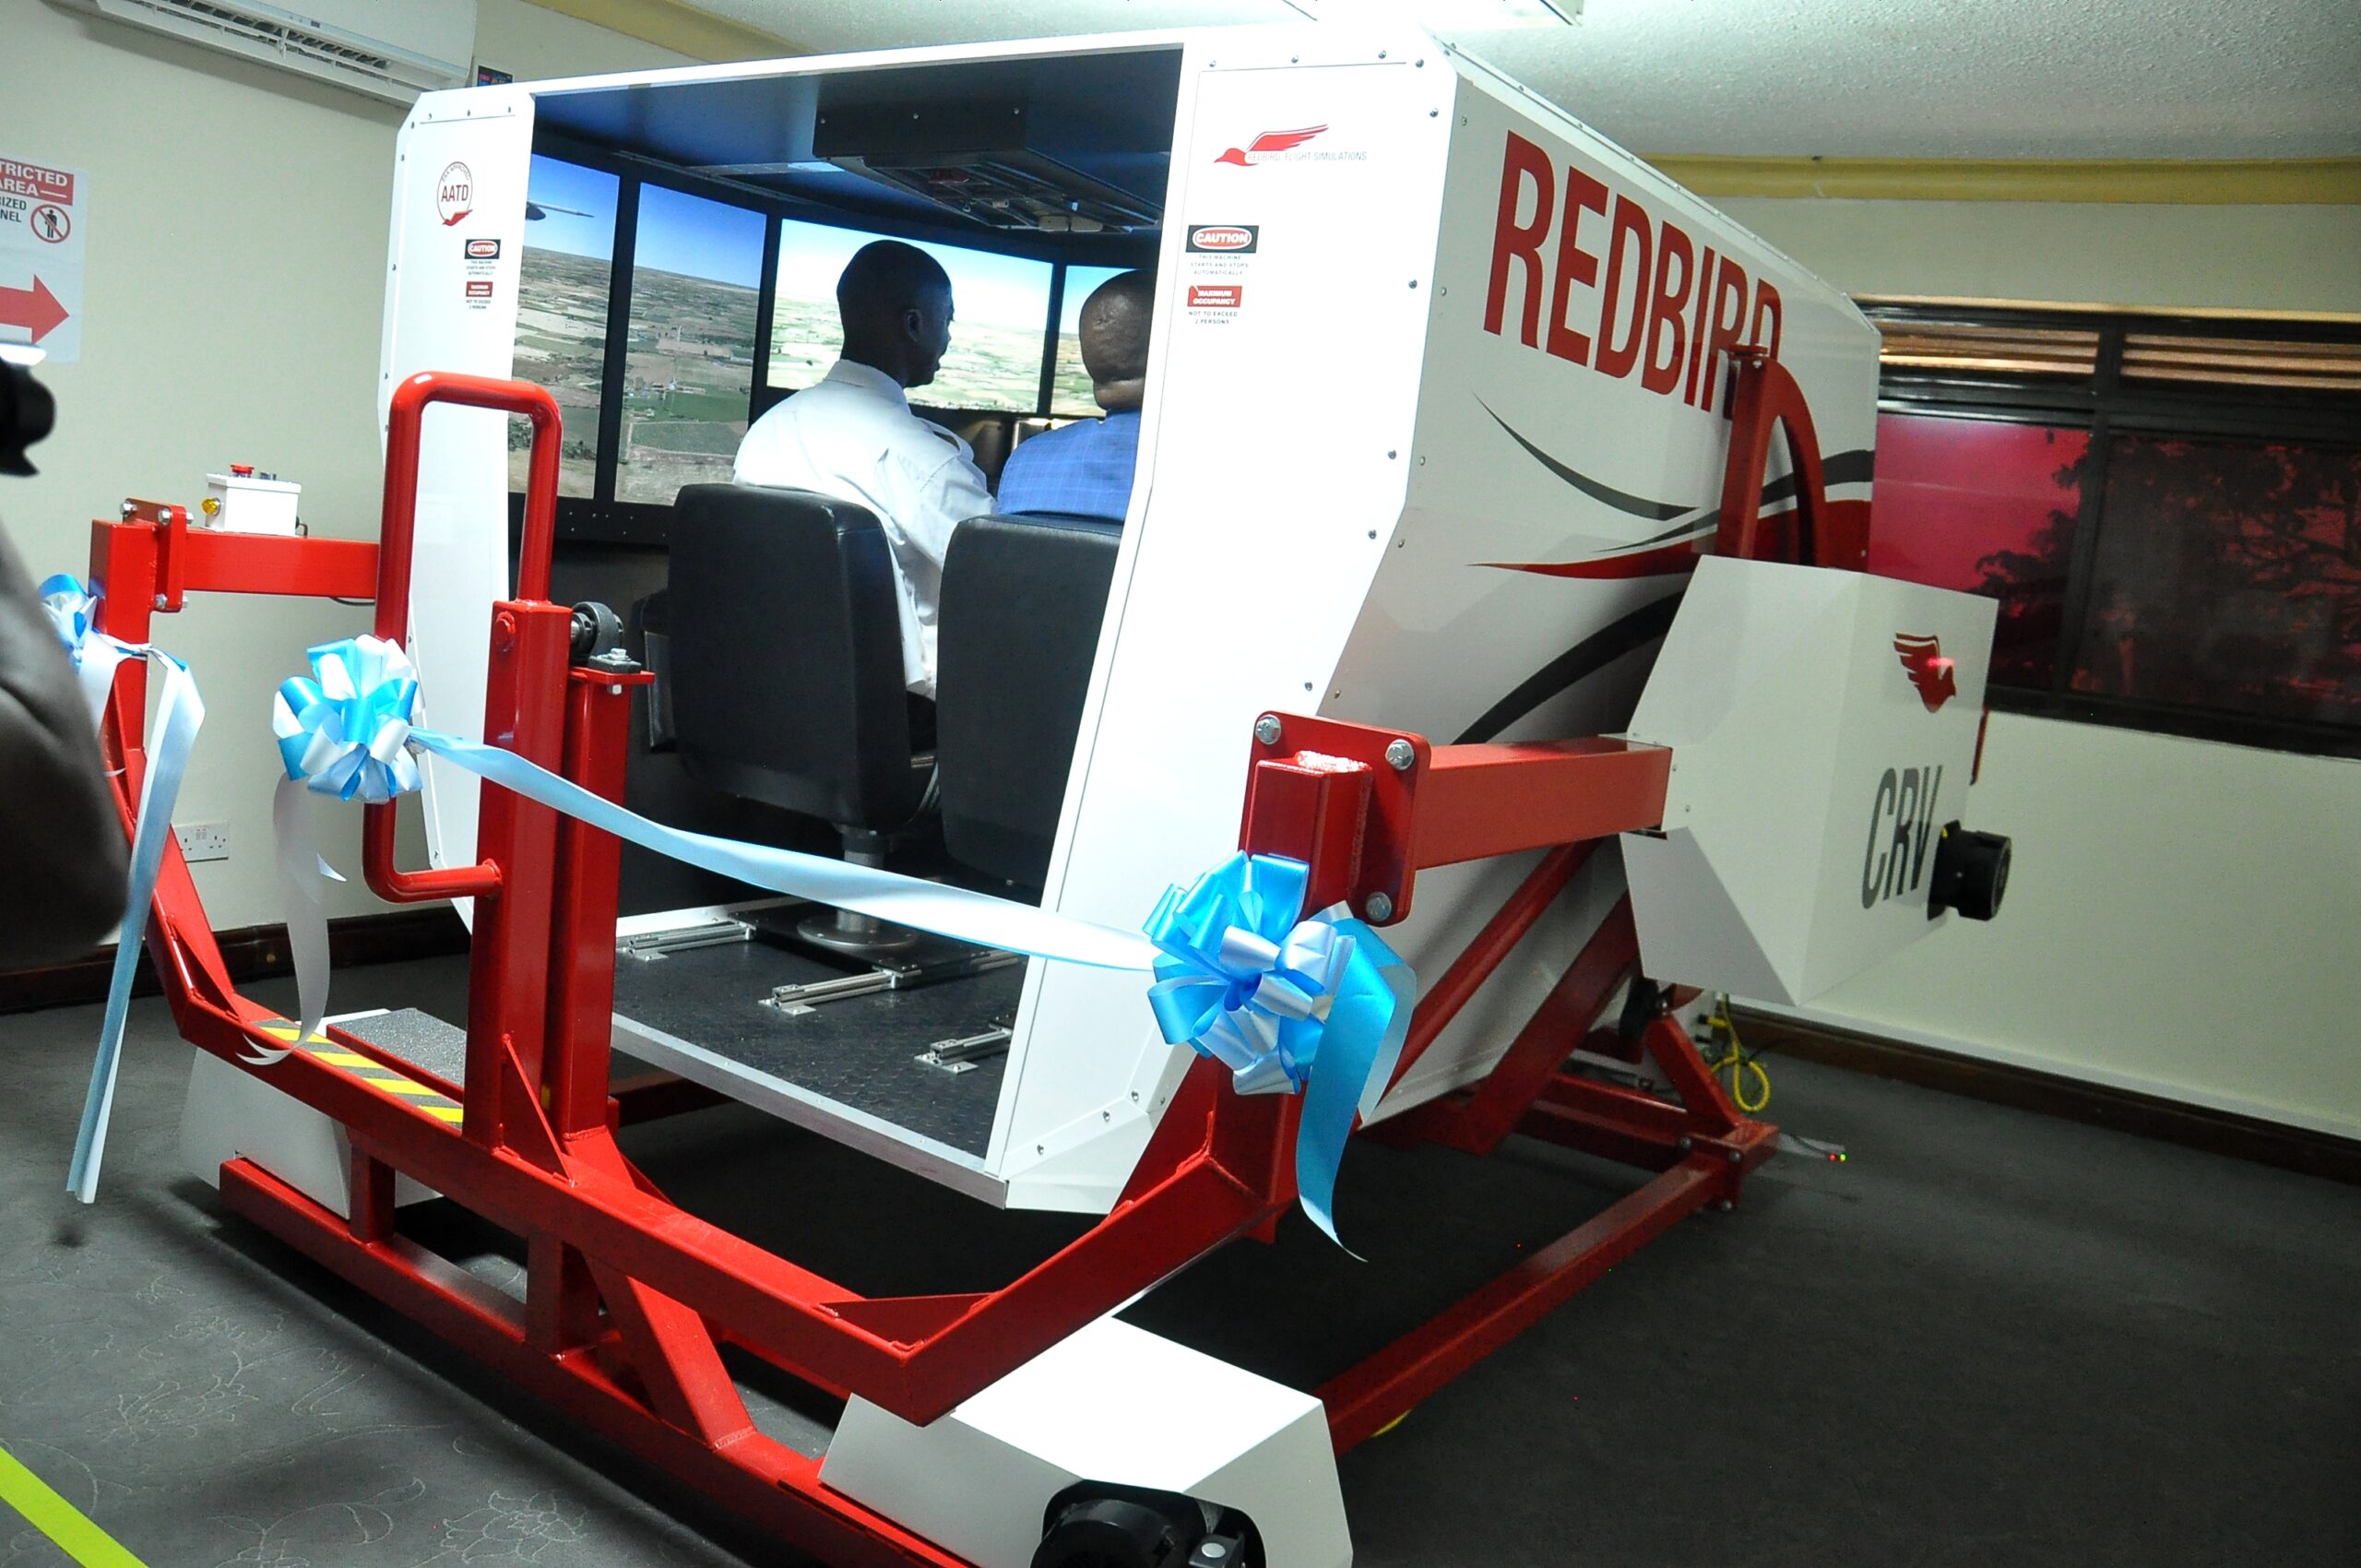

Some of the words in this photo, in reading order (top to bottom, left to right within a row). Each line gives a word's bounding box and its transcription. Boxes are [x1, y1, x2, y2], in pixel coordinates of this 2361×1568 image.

[1284, 152, 1311, 161] FLIGHT
[1313, 151, 1368, 161] SIMULATIONS
[441, 184, 469, 202] AATD
[1195, 232, 1249, 244] CAUTION
[1861, 765, 1943, 909] CRV
